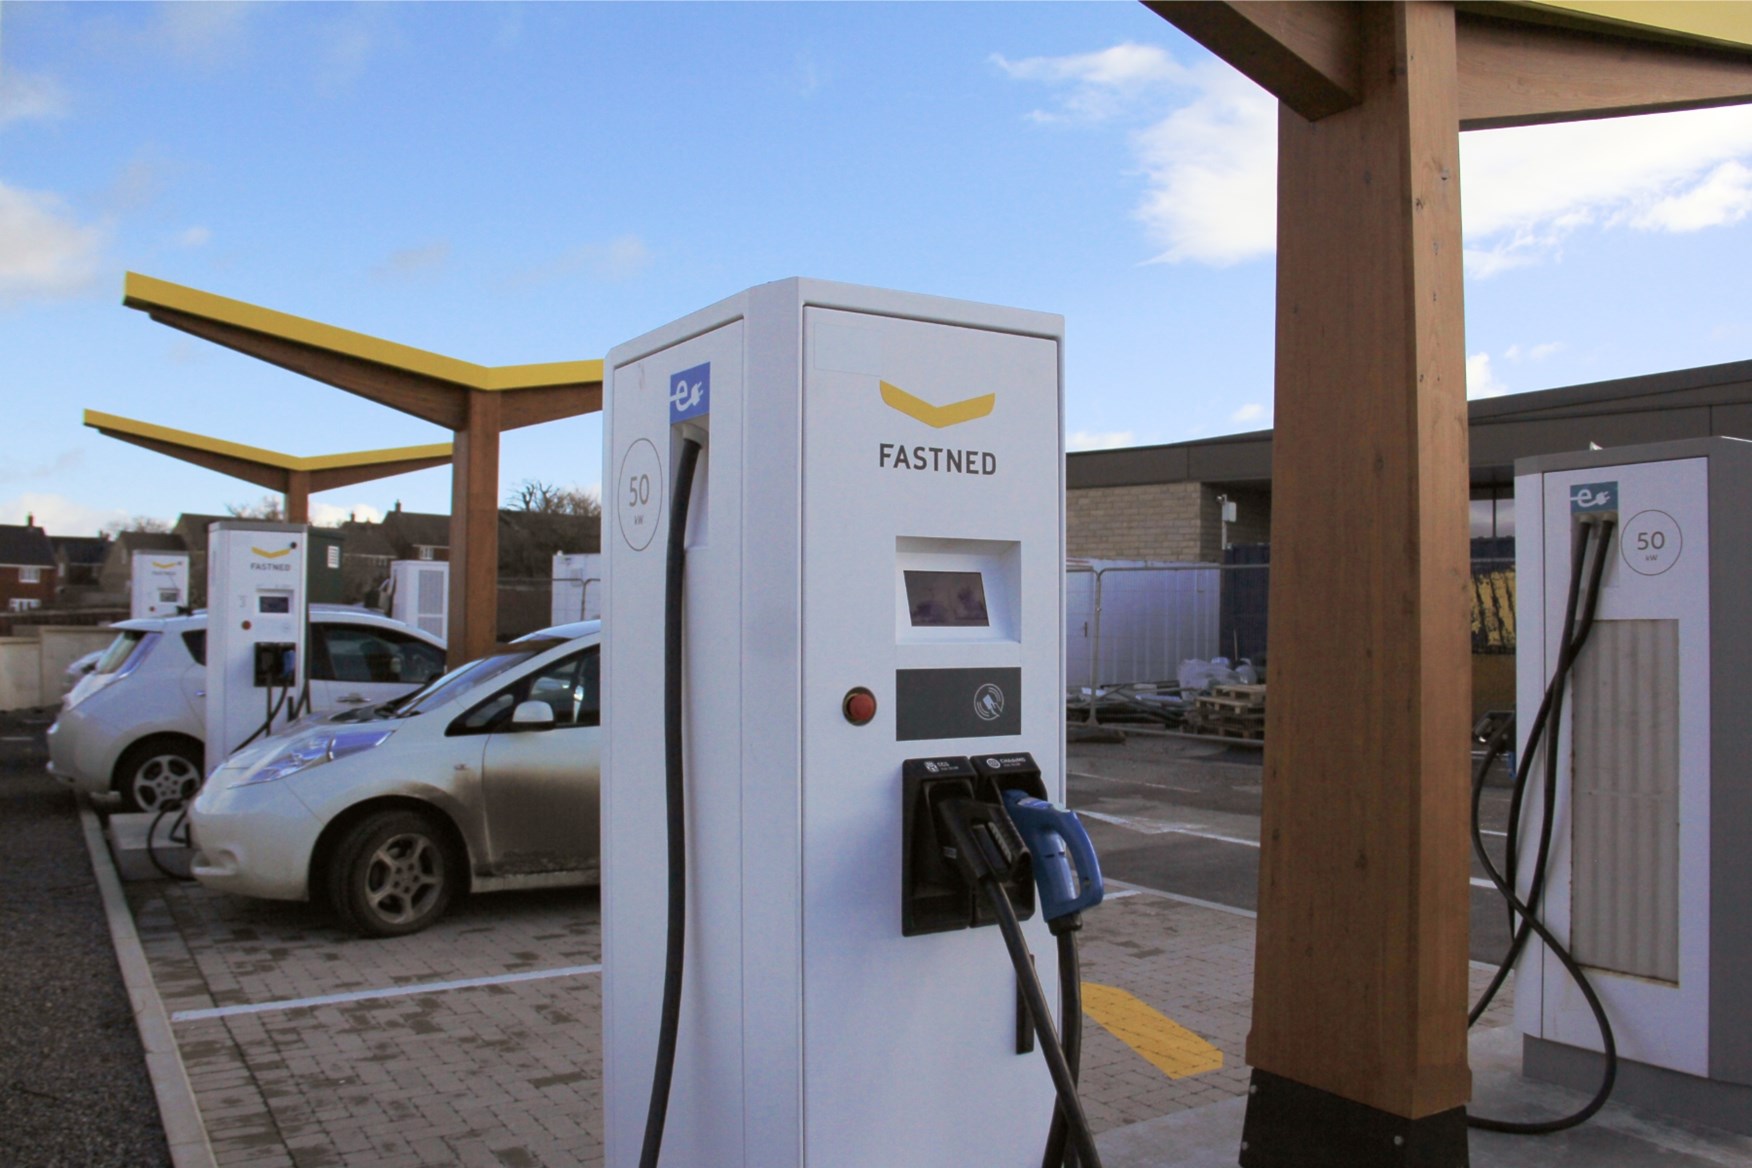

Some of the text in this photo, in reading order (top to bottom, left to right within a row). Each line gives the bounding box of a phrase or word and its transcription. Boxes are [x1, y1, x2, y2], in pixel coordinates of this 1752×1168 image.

[879, 443, 997, 475] FASTNED
[629, 474, 650, 507] 50
[1637, 531, 1665, 551] 50
[250, 562, 292, 572] FASTNED
